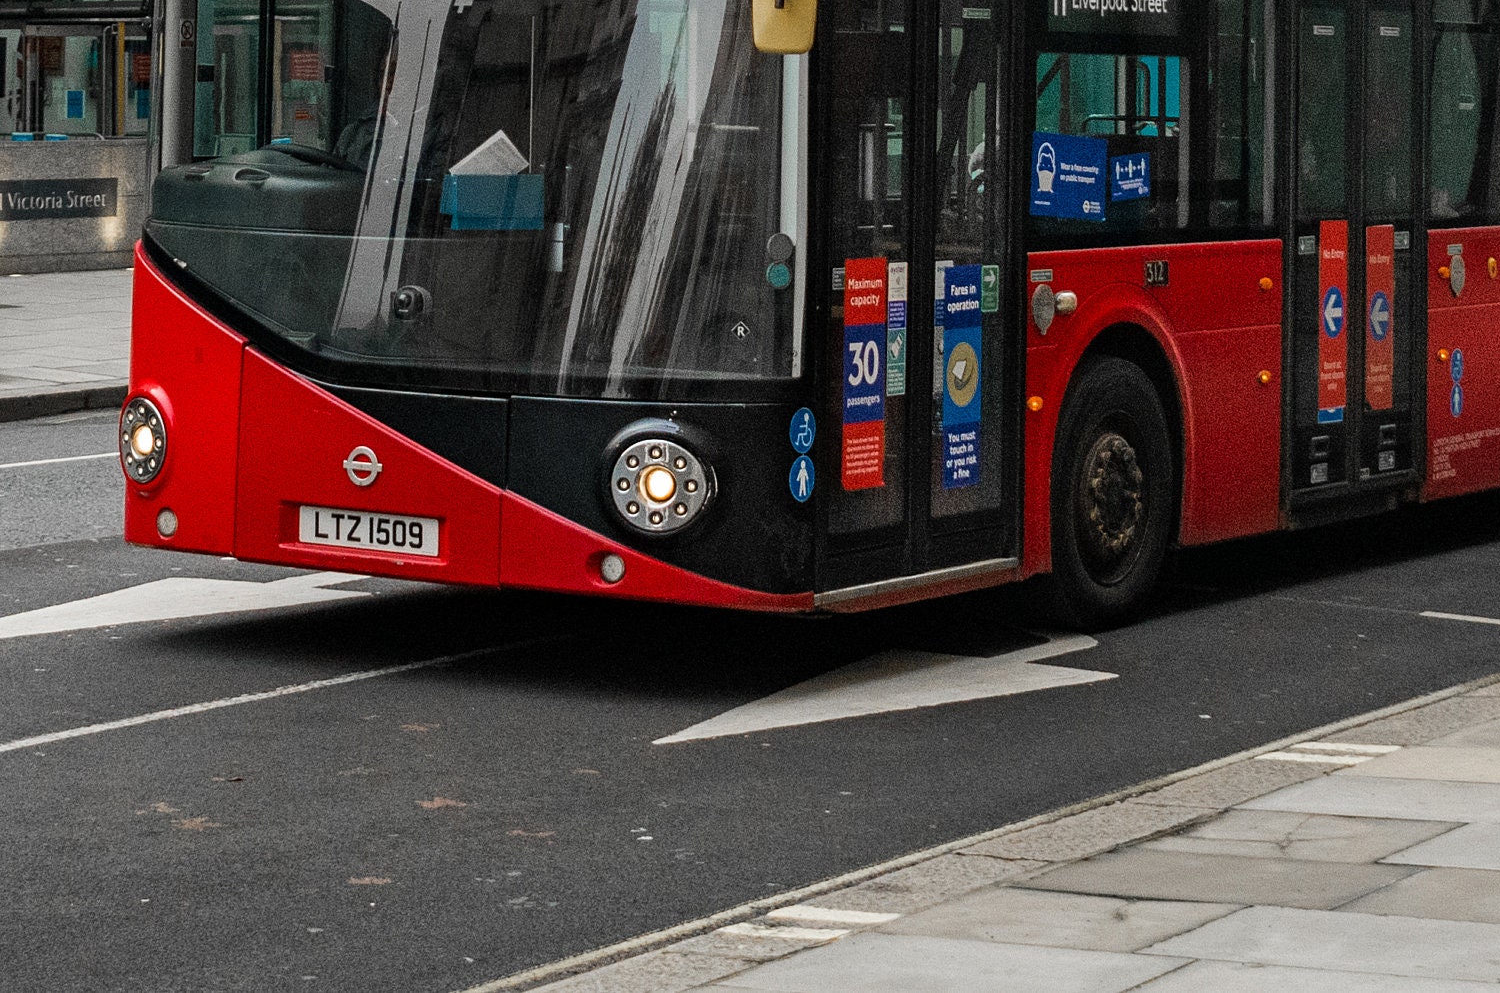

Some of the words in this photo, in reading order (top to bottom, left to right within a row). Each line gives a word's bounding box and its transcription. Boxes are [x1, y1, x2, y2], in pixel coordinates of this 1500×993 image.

[8, 191, 63, 210] Victoria
[66, 190, 107, 208] Street
[1146, 261, 1164, 283] 312
[847, 277, 883, 290] Maximum
[950, 284, 969, 296] Fares
[969, 283, 977, 294] in
[850, 293, 880, 308] capacity
[947, 298, 980, 313] operation
[737, 326, 746, 337] R
[848, 339, 879, 386] 30
[846, 395, 881, 409] passengers
[948, 432, 960, 443] You
[960, 430, 976, 441] must
[949, 443, 967, 455] touch
[967, 442, 974, 452] in
[946, 459, 954, 468] or
[953, 458, 966, 469] you
[966, 454, 977, 465] risk
[314, 511, 362, 543] LTZ
[369, 516, 423, 549] 1509
